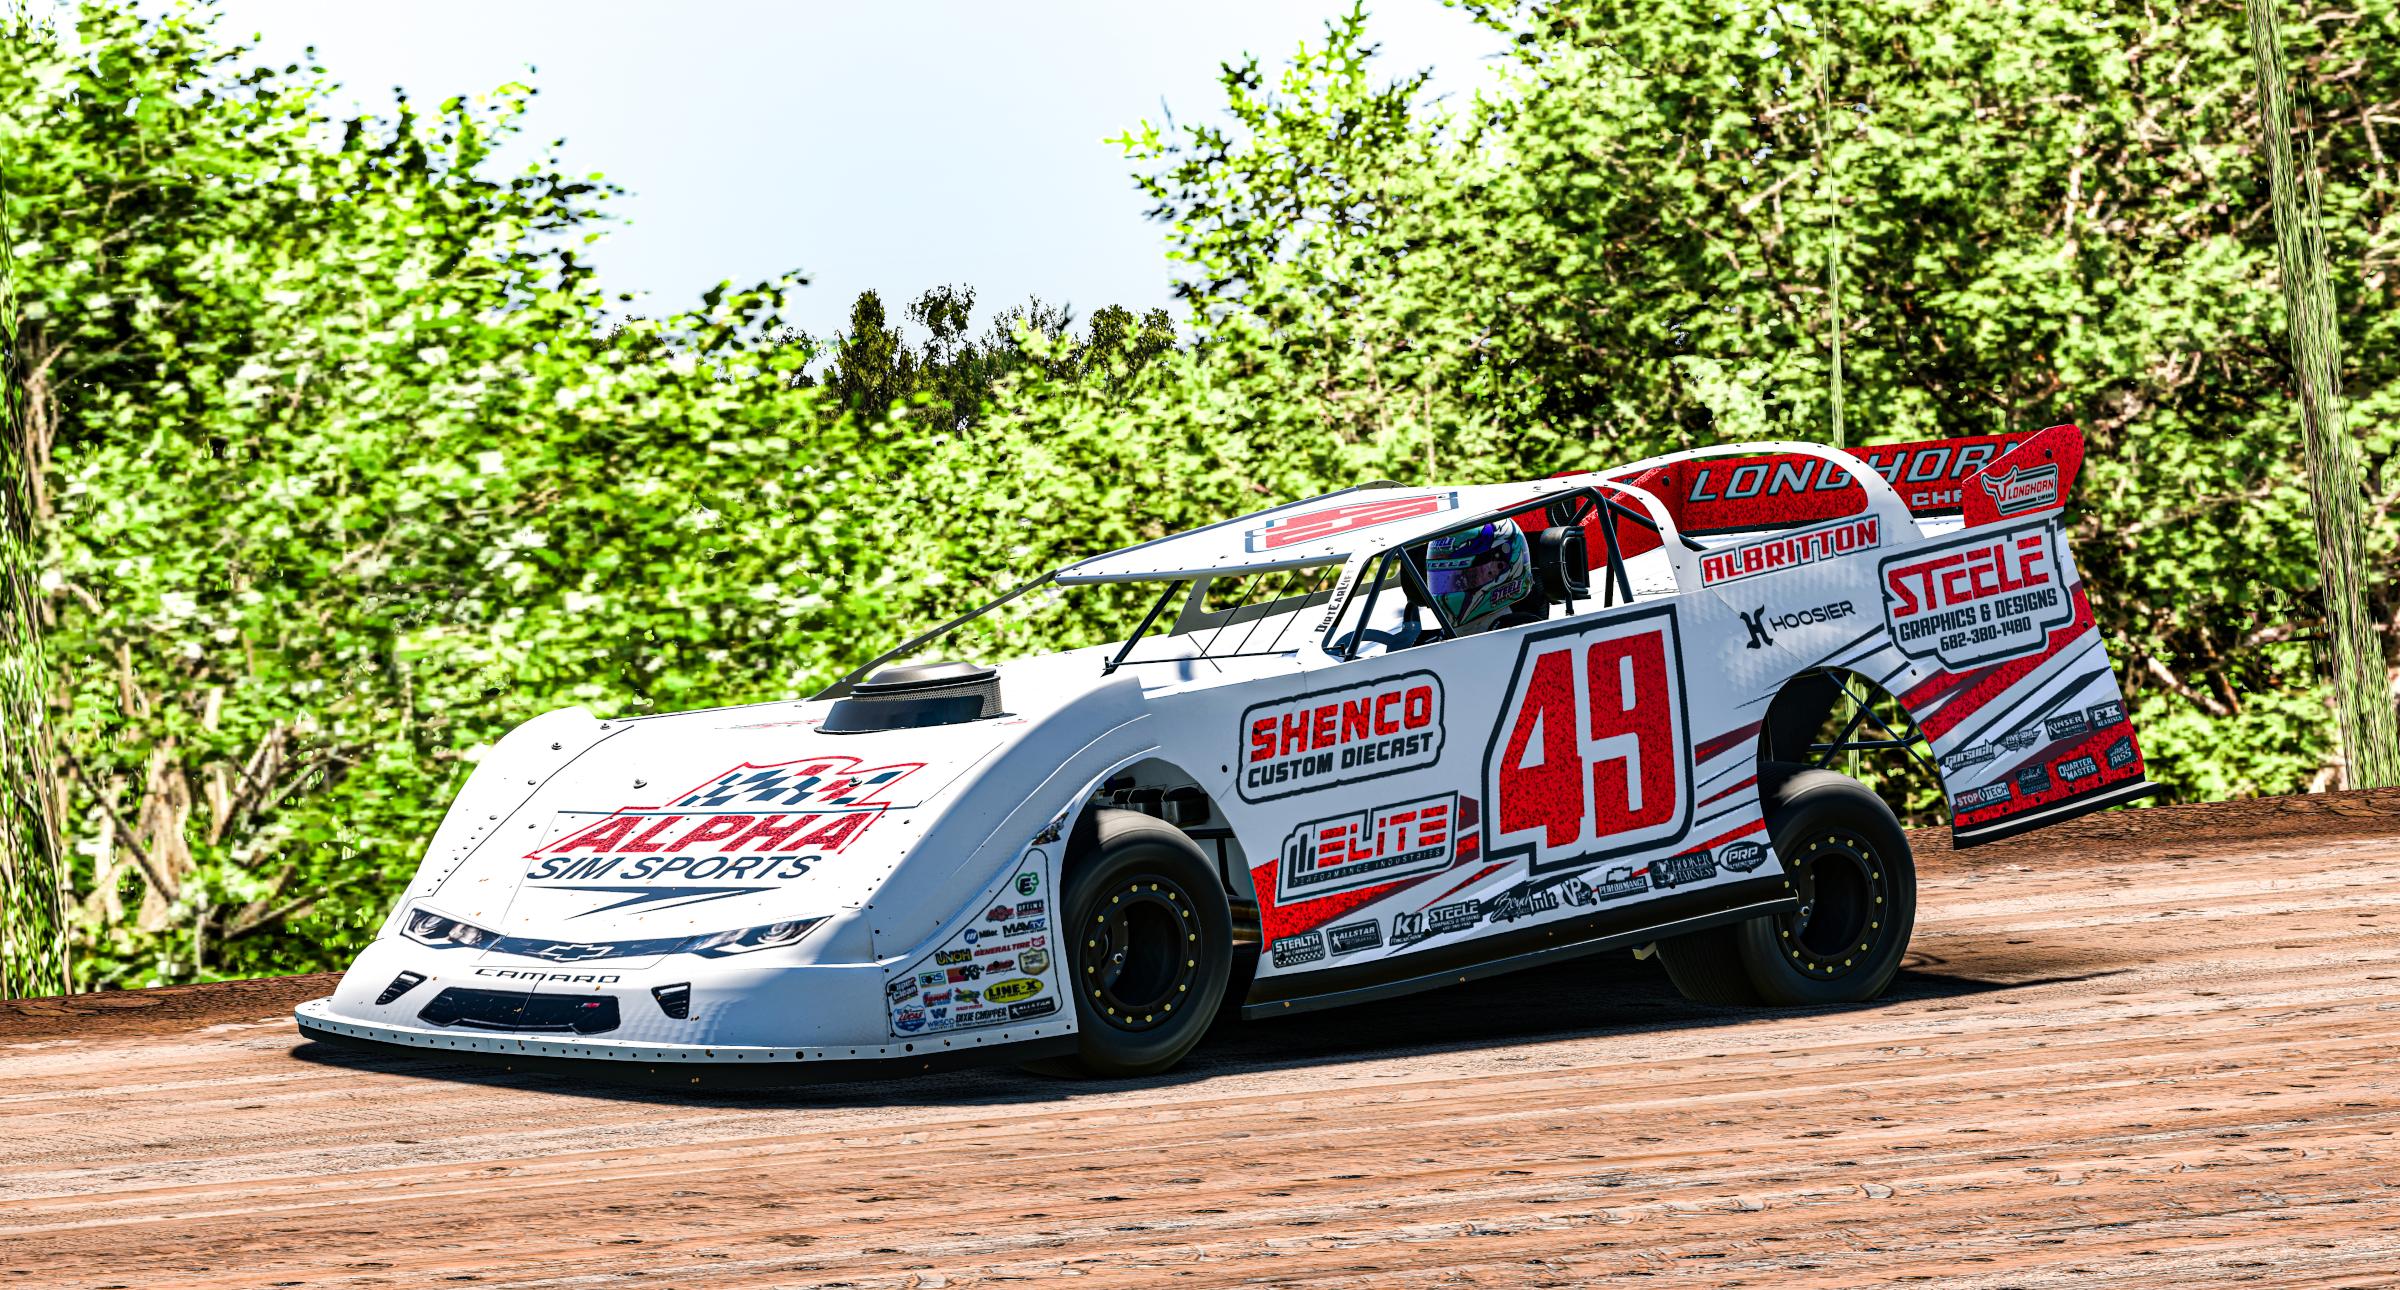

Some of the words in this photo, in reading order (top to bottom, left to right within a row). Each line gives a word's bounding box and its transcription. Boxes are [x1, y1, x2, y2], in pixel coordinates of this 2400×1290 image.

[1689, 441, 2018, 501] LONGHOR
[2008, 479, 2054, 499] LONGHORN
[1703, 520, 1878, 584] ALBRITTON
[1888, 535, 2049, 618] STEELE
[1769, 600, 1856, 632] HOOSIER
[1899, 606, 1976, 642] GRAPHICS
[1980, 603, 1991, 622] &
[1995, 588, 2058, 619] DESIGNS
[1940, 616, 2031, 652] 682-380-1480
[1251, 685, 1433, 762] SHENCO
[2047, 716, 2082, 736] KINSER
[1500, 630, 1676, 848] 49
[1248, 752, 1333, 788] CUSTOM
[1341, 732, 1433, 769] DIECAST
[2058, 757, 2093, 777] QUARTER
[2066, 764, 2097, 780] MASTER
[551, 812, 873, 854] ALPHA
[1317, 804, 1448, 869] ELITE
[1671, 854, 1711, 872] HOOKER
[1729, 846, 1758, 863] PRP
[526, 857, 625, 880] SIM
[620, 855, 822, 880] SPORTS
[1293, 863, 1369, 886] PERFORMANCE
[1375, 848, 1441, 869] INDUSTRIES
[1673, 868, 1714, 882] HARNESS
[1430, 901, 1479, 923] STEELE
[1340, 926, 1375, 940] ALLSTAR
[1394, 914, 1421, 936] K1
[974, 944, 1011, 957] GENERAL
[1012, 941, 1031, 951] TIRE
[1275, 934, 1320, 953] STEALTH
[935, 948, 973, 966] UNOH
[474, 968, 621, 984] CAMARO
